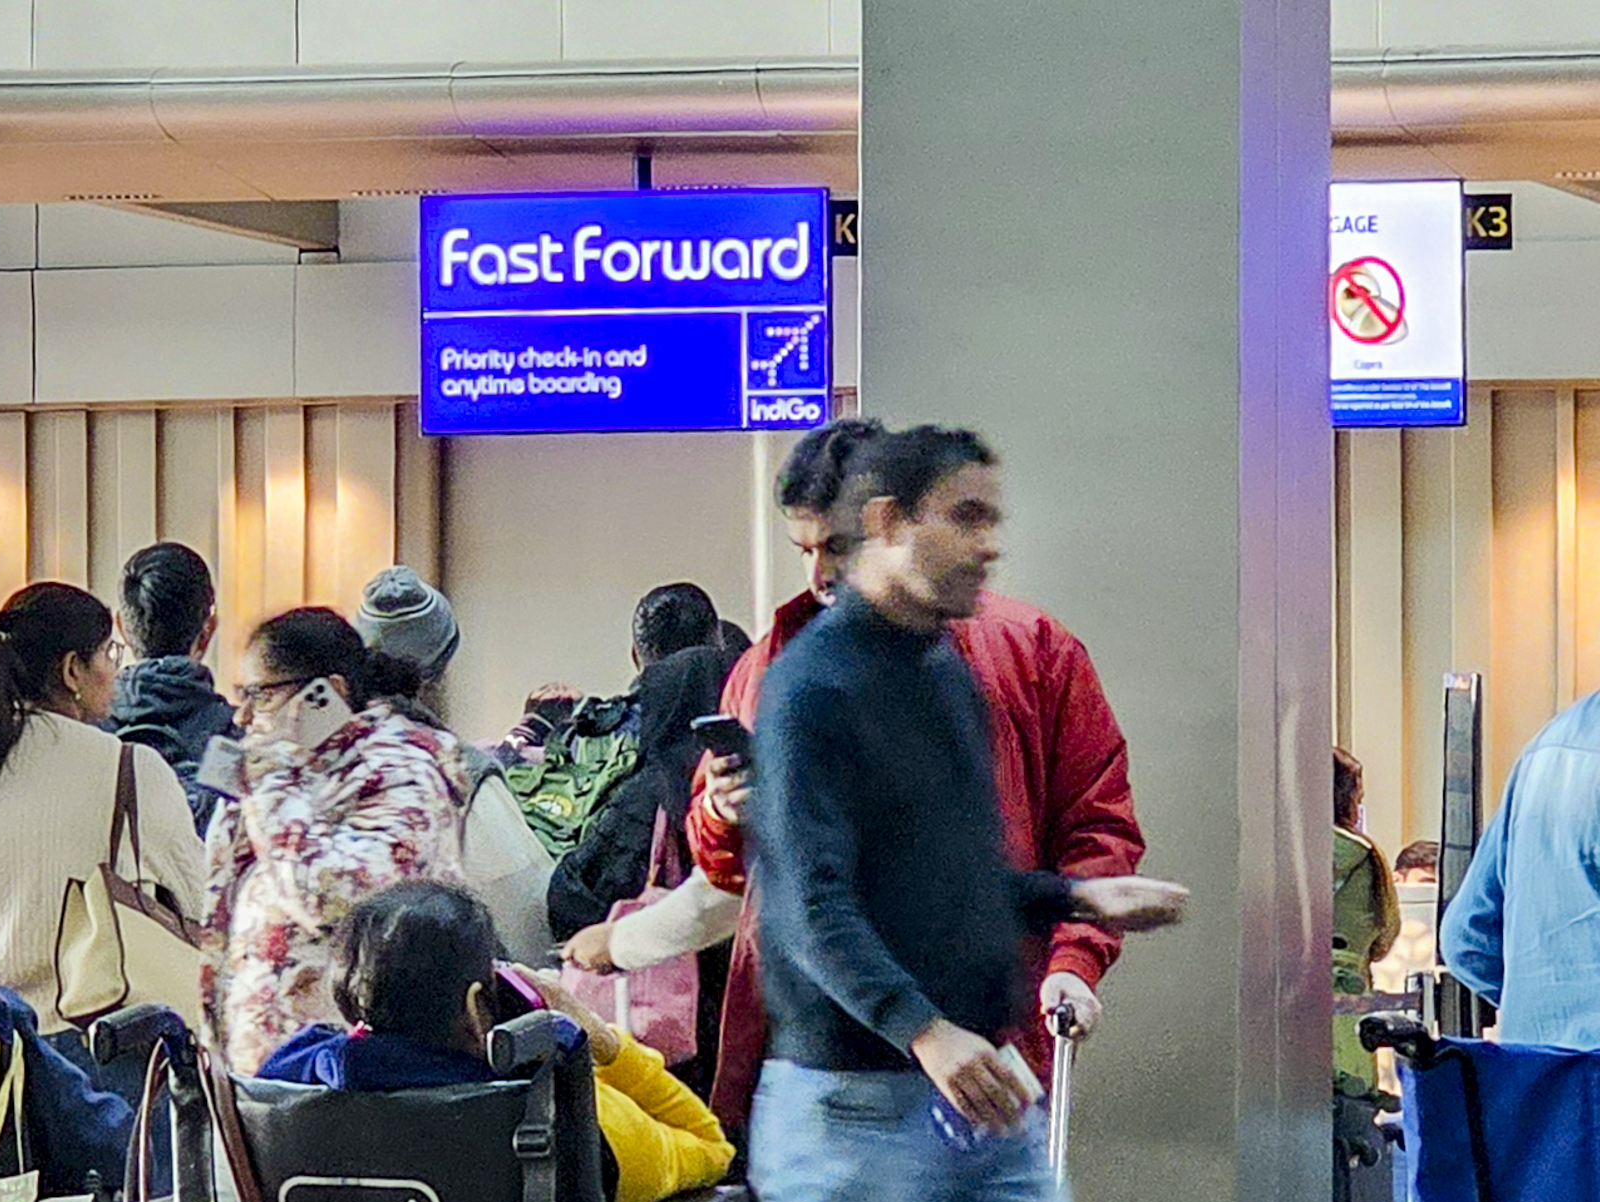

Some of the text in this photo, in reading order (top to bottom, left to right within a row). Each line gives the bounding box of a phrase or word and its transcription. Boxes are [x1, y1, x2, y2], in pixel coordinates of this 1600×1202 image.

[1466, 206, 1508, 238] K3
[440, 344, 648, 375] Priority check-in and
[441, 371, 623, 402] anytime boarding
[750, 396, 821, 421] IndiGo
